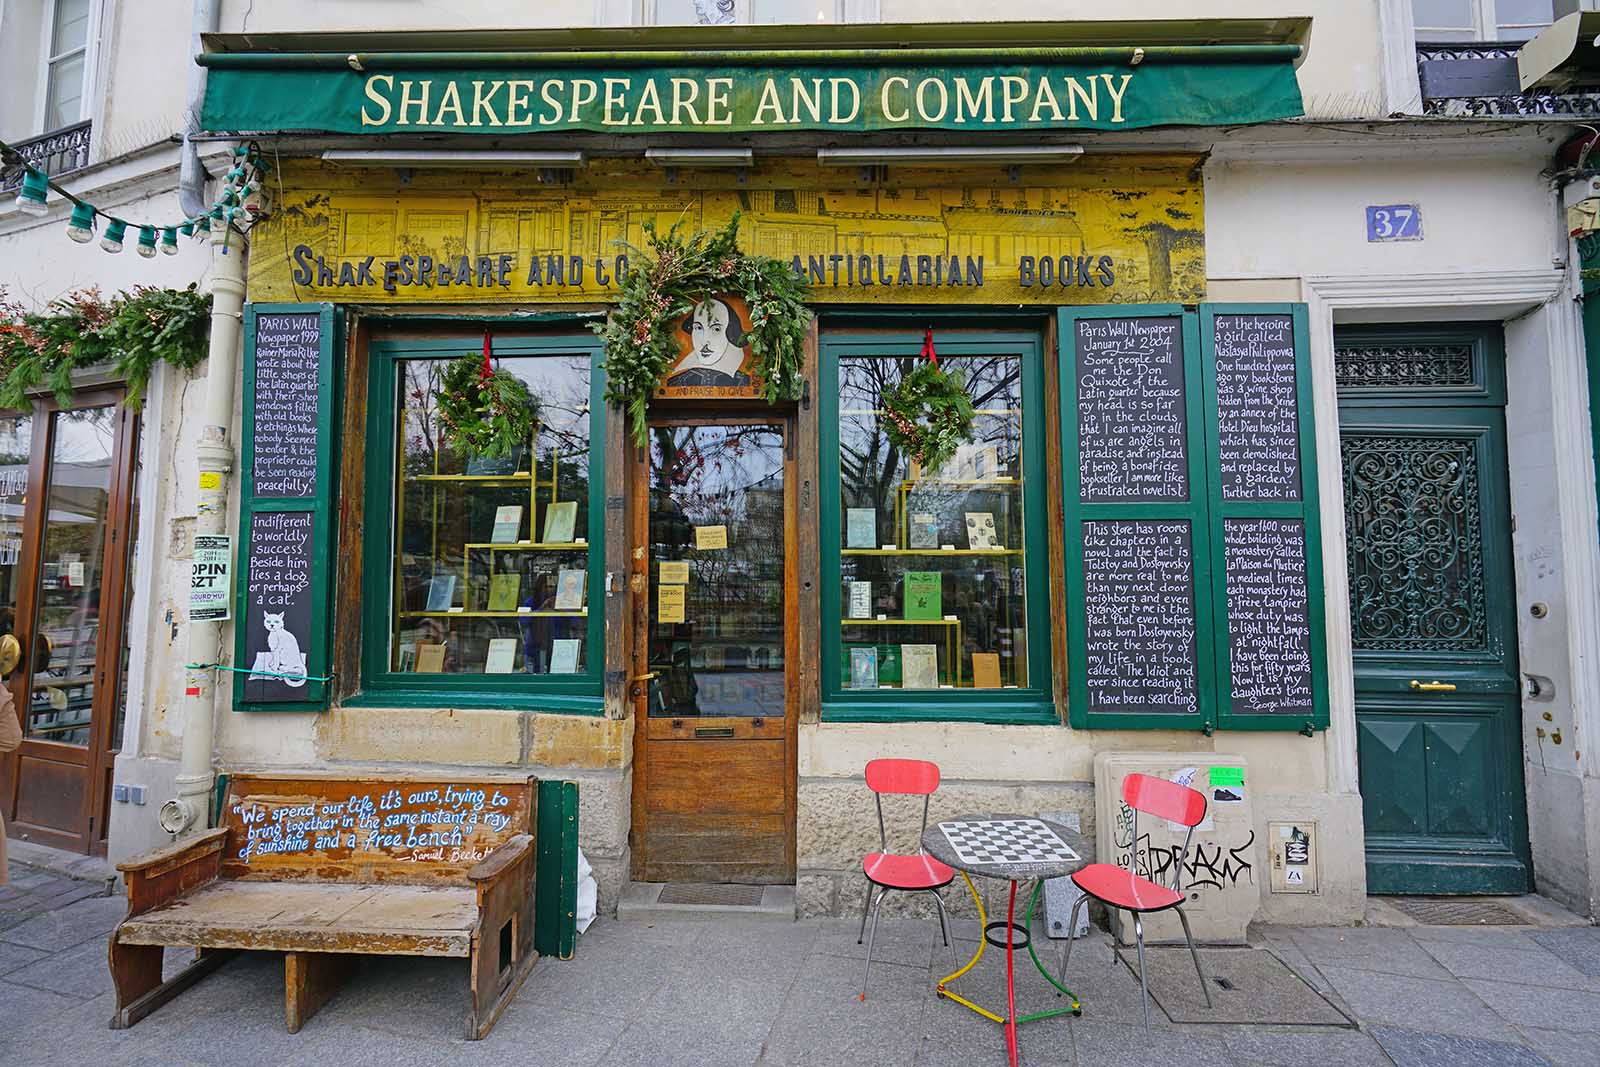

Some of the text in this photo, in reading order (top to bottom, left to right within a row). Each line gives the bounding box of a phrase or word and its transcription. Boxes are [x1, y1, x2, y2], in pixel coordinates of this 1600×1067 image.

[361, 74, 1133, 127] SHAKESPEARE AND COMPANY
[1375, 210, 1413, 237] 37
[527, 253, 584, 287] AND
[1019, 254, 1115, 287] BOOKS
[259, 316, 320, 330] PARIS WALL
[1079, 320, 1175, 341] Paris Wall Newspaper
[1215, 316, 1291, 330] for the heroine
[256, 331, 319, 346] Newspaper 1999
[1214, 329, 1284, 346] a girl called
[256, 346, 320, 359] Rainer Maria Rilke
[1083, 336, 1173, 357] January 1st 2004
[256, 358, 319, 370] wrote about the
[1083, 352, 1172, 369] Some people call
[281, 369, 307, 382] shops
[307, 370, 319, 382] of
[1092, 364, 1162, 376] me the Don
[1080, 374, 1169, 389] Quixote of the
[1079, 385, 1182, 401] Latin quarter because
[255, 401, 318, 414] windows filled
[1083, 410, 1178, 426] up in the clouds
[254, 432, 317, 445] nobody seemed
[1219, 433, 1296, 447] which has since
[254, 444, 316, 455] to enter & the
[1126, 448, 1143, 458] and
[1146, 447, 1185, 459] instead
[1219, 446, 1297, 461] been demolished
[254, 455, 317, 468] proprietor could
[1220, 459, 1296, 478] and replaced by
[1235, 472, 1292, 487] a garden.
[1222, 484, 1297, 499] Further back in
[254, 513, 311, 530] indifferent
[1083, 521, 1188, 536] This store has rooms
[252, 528, 308, 546] to worldly
[1109, 535, 1157, 549] chapters
[1159, 534, 1169, 545] in
[1174, 535, 1182, 545] a
[256, 545, 307, 556] success.
[1084, 545, 1189, 558] novel and the fact is
[250, 555, 308, 568] Beside him
[250, 568, 309, 587] lies a dog
[1226, 571, 1304, 585] In medieval times
[249, 581, 302, 595] or perhaps
[256, 593, 295, 606] a cat.
[1228, 621, 1309, 640] to light the lamps
[1235, 634, 1304, 653] at nightfall.
[1098, 690, 1121, 704] have
[1122, 689, 1145, 704] been
[1147, 690, 1197, 712] searching
[1231, 684, 1312, 703] daughter's turn.
[1280, 696, 1312, 707] Whitman
[271, 803, 316, 823] spend
[321, 804, 344, 815] our
[346, 795, 377, 818] life,
[379, 789, 402, 810] it's
[408, 788, 443, 805] ours,
[444, 784, 486, 811] trying
[491, 790, 509, 806] to
[247, 808, 511, 842] bring together in the same instant a ray
[238, 841, 255, 864] of
[256, 834, 310, 855] sunshine
[314, 830, 340, 849] and
[347, 833, 357, 848] a
[364, 829, 402, 851] free
